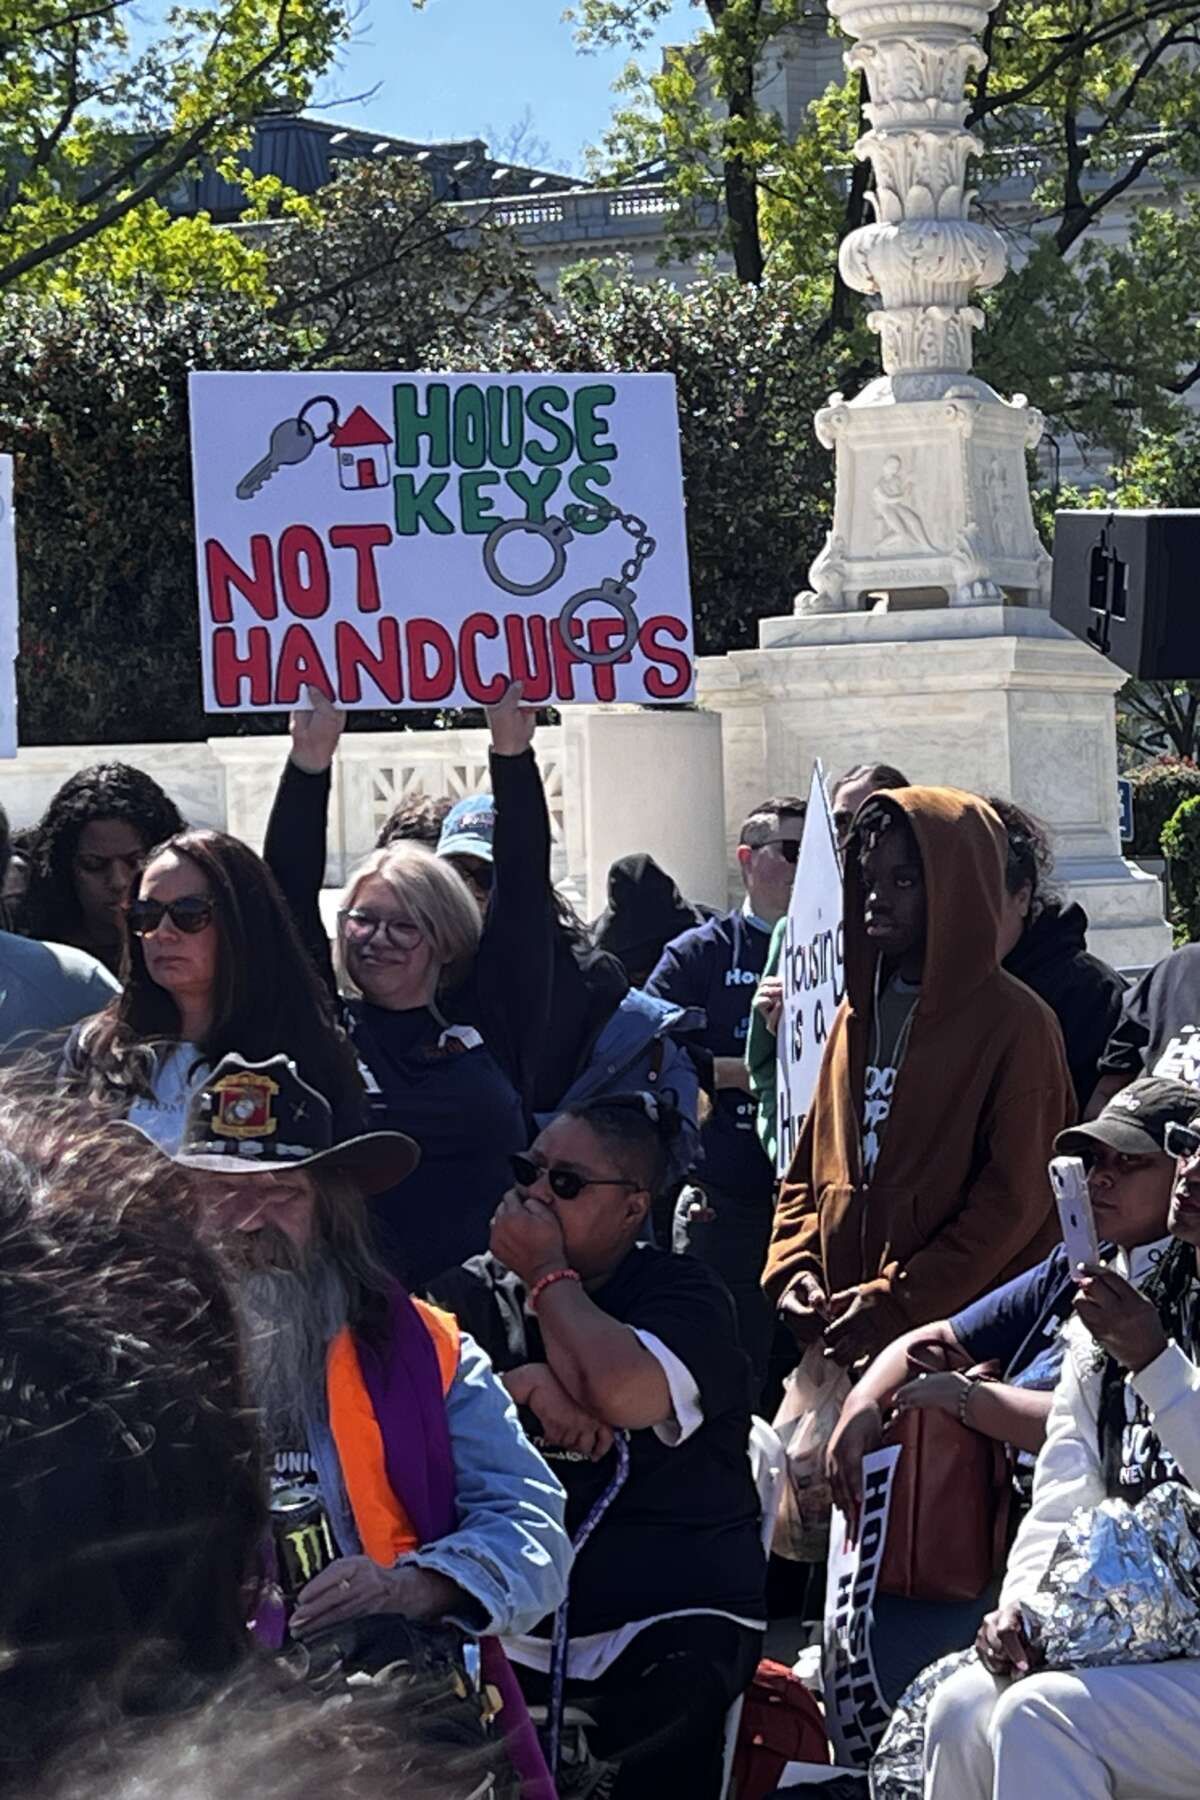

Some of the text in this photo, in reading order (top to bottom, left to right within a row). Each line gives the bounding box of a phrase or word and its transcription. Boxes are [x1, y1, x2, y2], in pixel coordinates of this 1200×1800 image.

[393, 383, 618, 470] HOUSE
[393, 463, 614, 536] KEYS
[205, 524, 393, 625] NOT
[212, 611, 693, 708] HANDCUFFS
